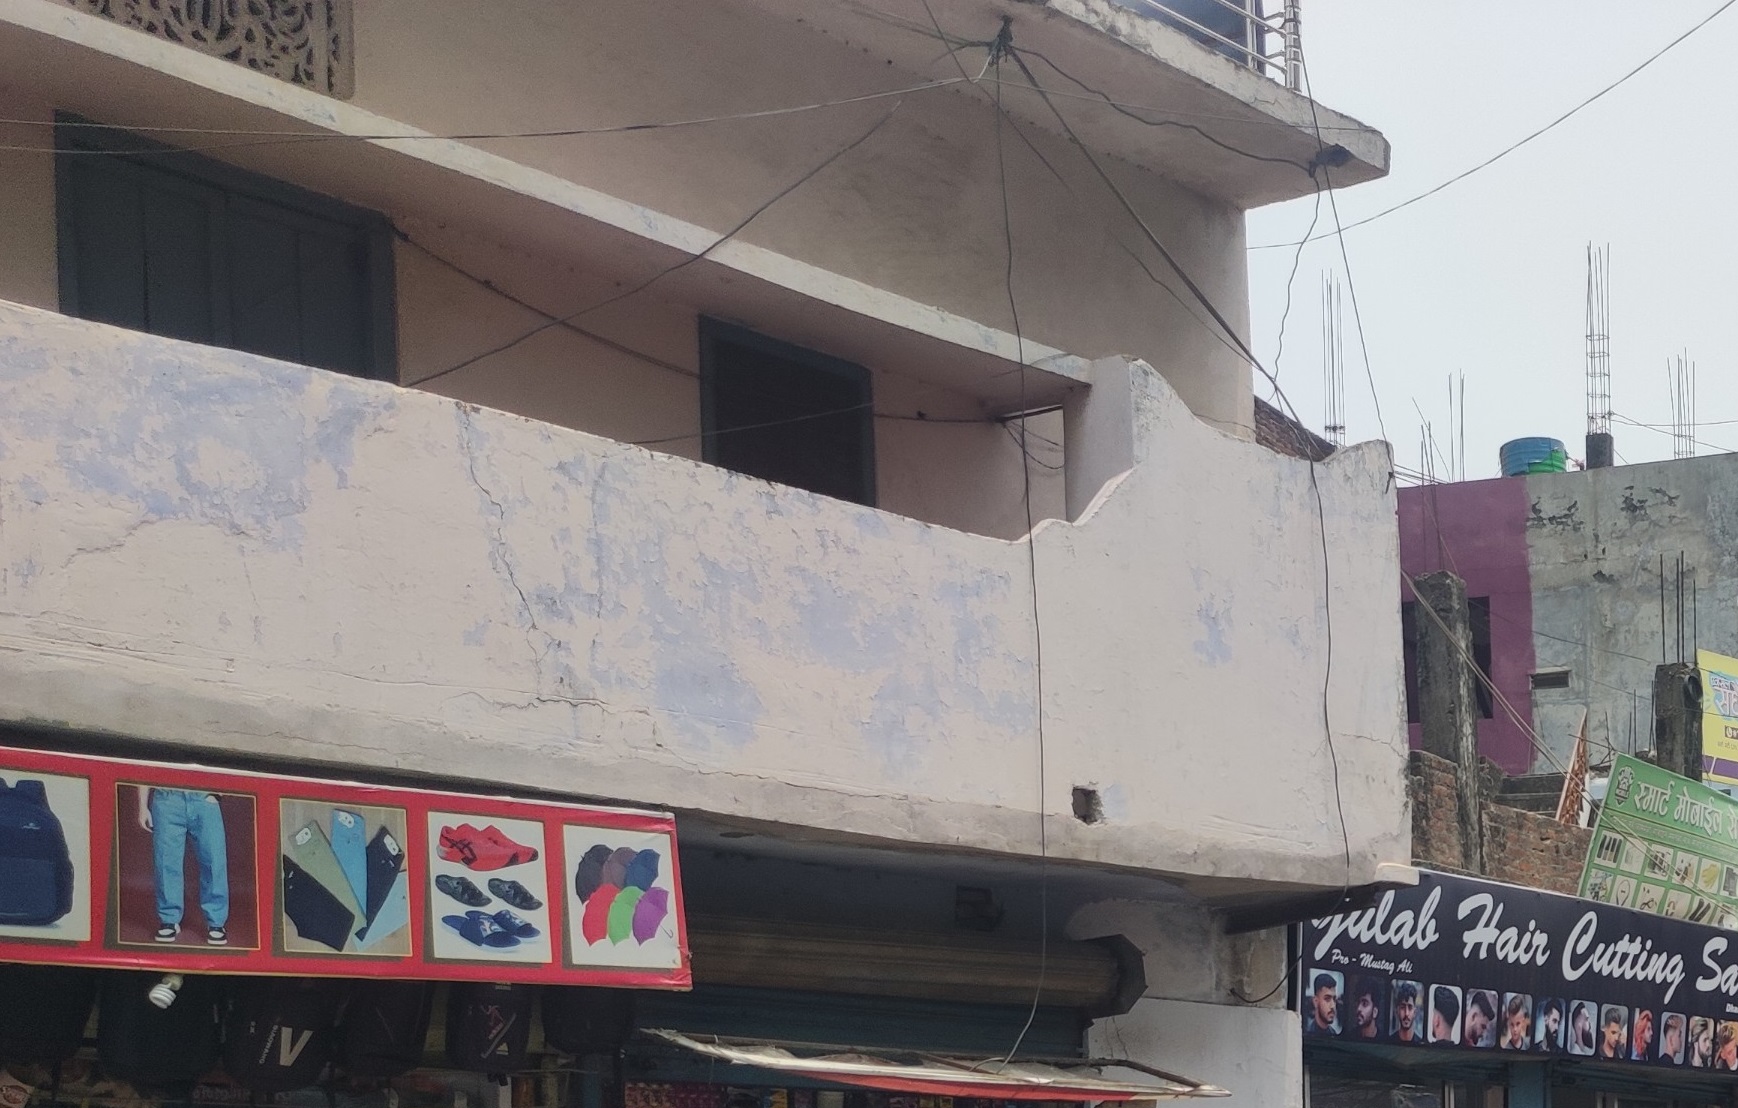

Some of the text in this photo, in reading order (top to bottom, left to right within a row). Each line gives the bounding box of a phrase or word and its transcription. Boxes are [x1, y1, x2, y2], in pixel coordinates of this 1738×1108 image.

[1331, 948, 1350, 965] Pro
[1397, 960, 1414, 974] Ali
[1458, 893, 1550, 967] Hair
[1562, 911, 1688, 1005] Cutting
